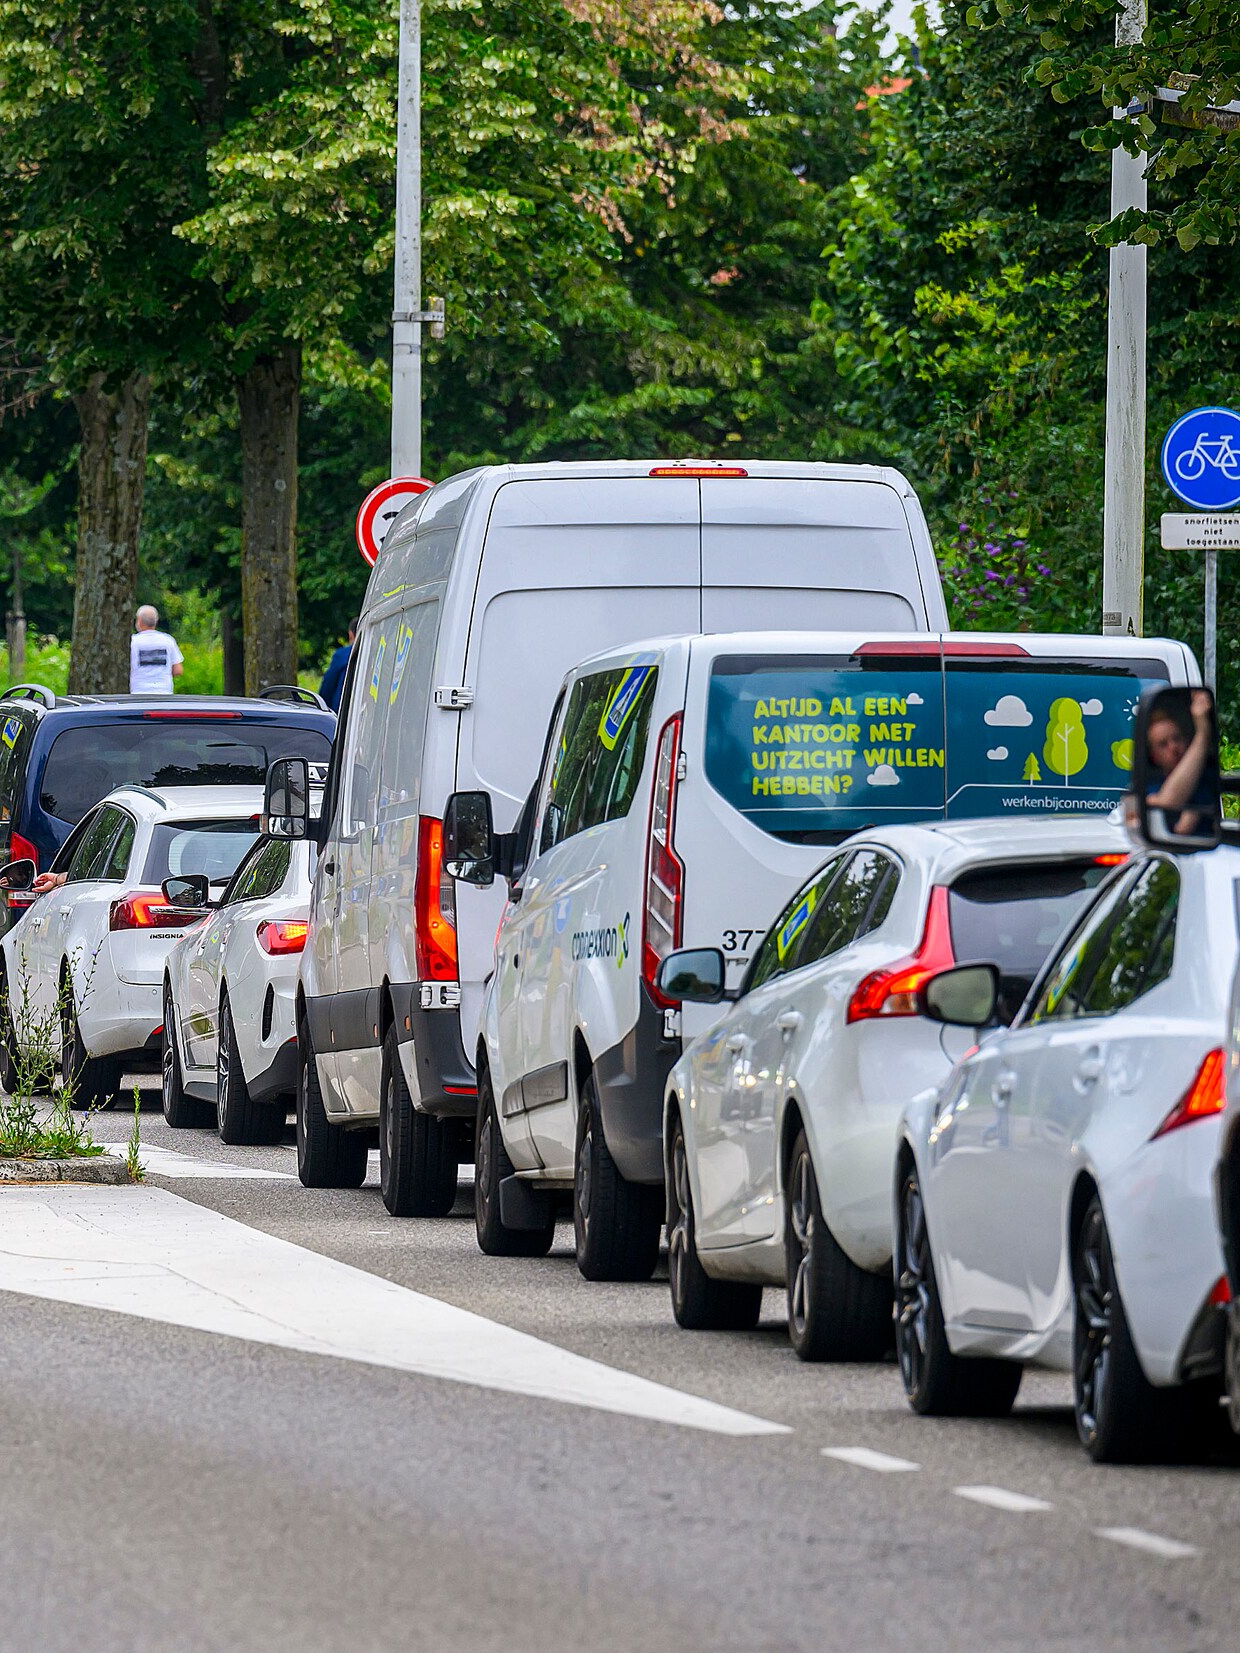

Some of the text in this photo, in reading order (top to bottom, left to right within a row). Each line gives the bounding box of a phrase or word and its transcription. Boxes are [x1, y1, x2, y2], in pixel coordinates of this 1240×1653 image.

[1184, 517, 1240, 526] snorfietsen
[1203, 528, 1223, 536] niet
[1186, 538, 1240, 547] toegestaan
[754, 697, 908, 719] ALTIJD AL EEN
[752, 722, 917, 745] KANTOOR MET
[751, 748, 945, 770] UITZICHT WILLEN
[752, 774, 854, 796] HEBBEN?
[722, 930, 766, 951] 37
